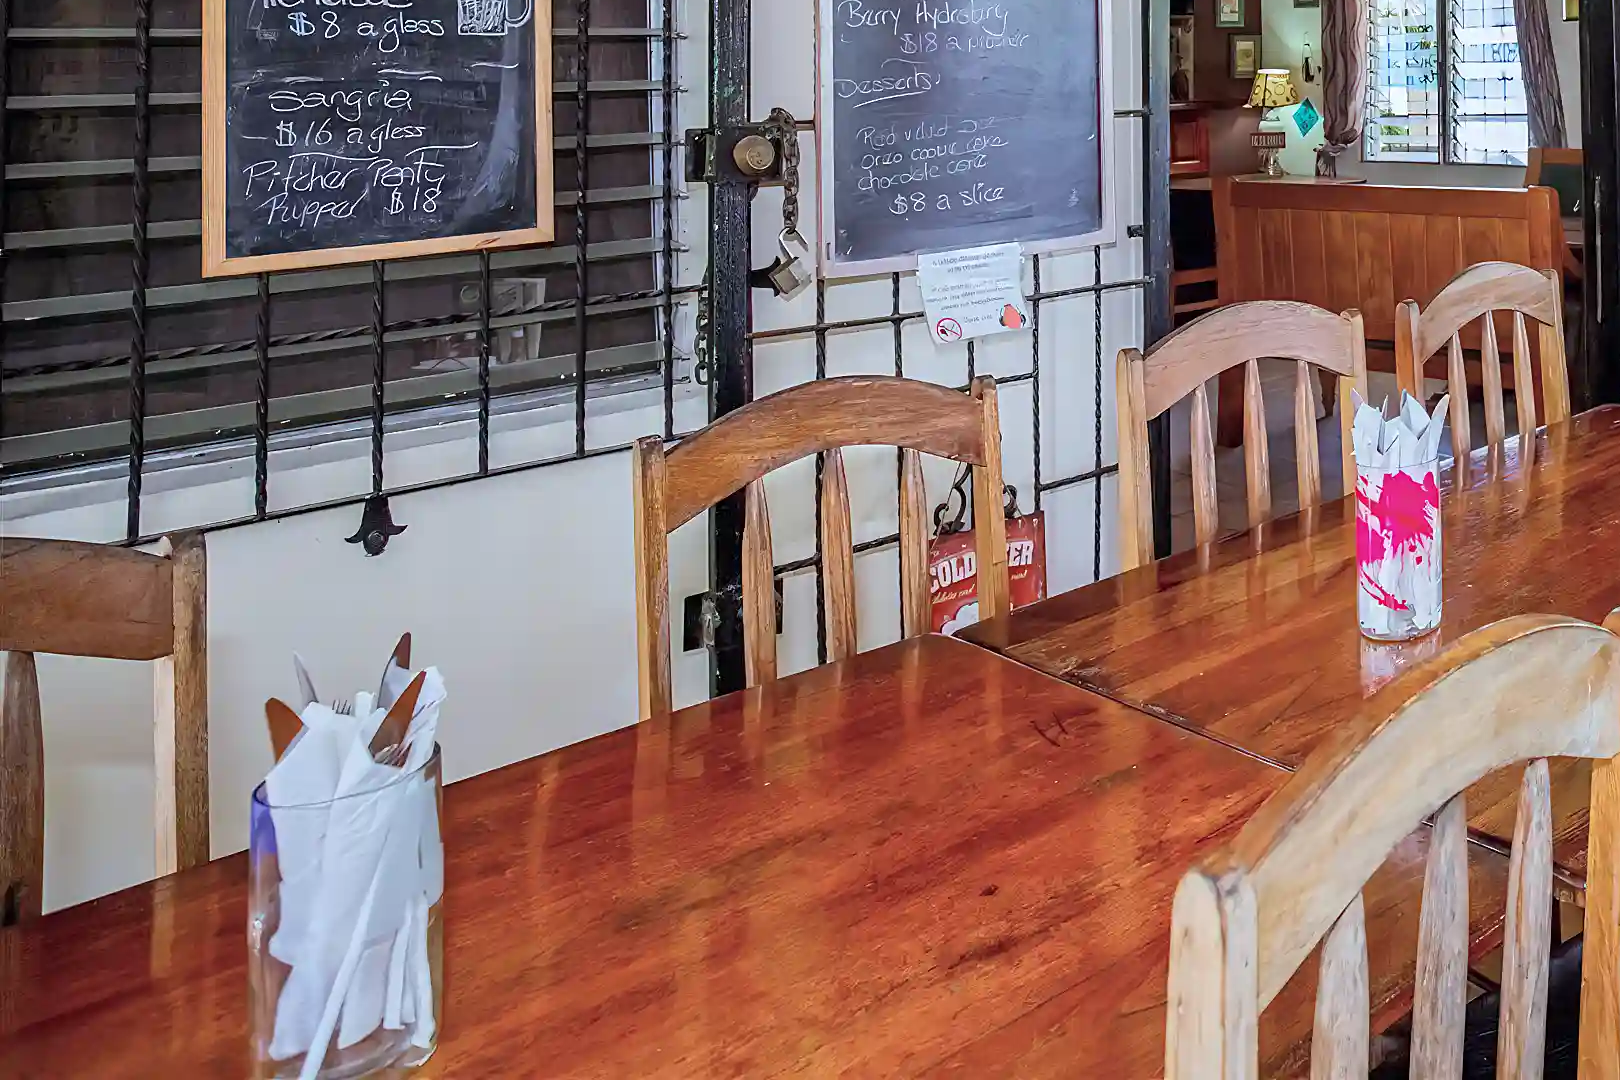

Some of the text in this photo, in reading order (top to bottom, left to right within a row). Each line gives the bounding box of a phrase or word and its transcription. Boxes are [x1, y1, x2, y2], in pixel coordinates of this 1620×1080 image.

[288, 10, 444, 53] $8 a glass
[899, 31, 938, 54] $18
[268, 80, 412, 121] Sangria
[275, 118, 332, 147] $16
[347, 127, 364, 145] a
[243, 158, 360, 196] Pitcher
[383, 186, 442, 216] $18
[889, 182, 1006, 215] $8 a slice
